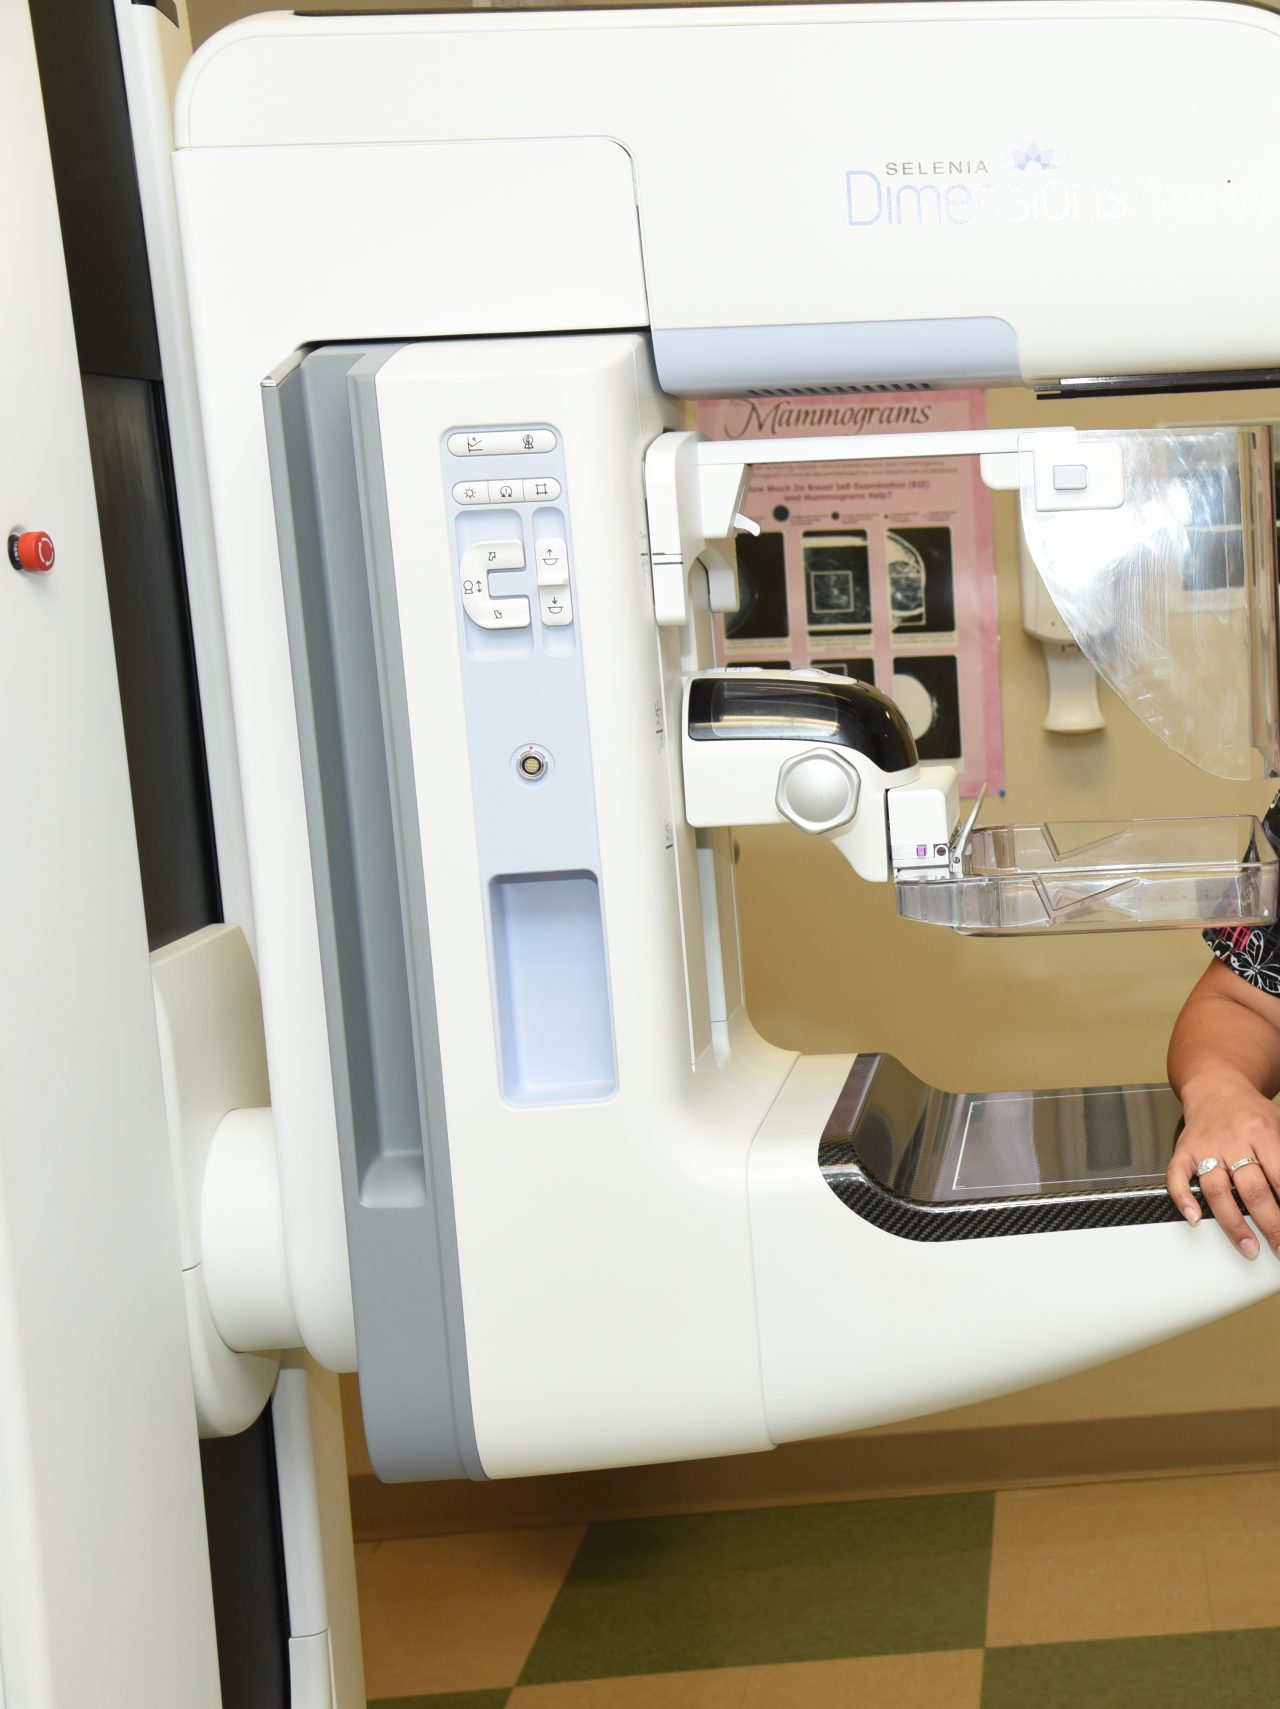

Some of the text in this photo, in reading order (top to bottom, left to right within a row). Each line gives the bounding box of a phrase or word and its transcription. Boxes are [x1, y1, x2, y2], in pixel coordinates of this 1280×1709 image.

[885, 160, 989, 176] SELENIA
[846, 170, 1128, 226] Dimensions
[724, 399, 932, 439] Mammograms
